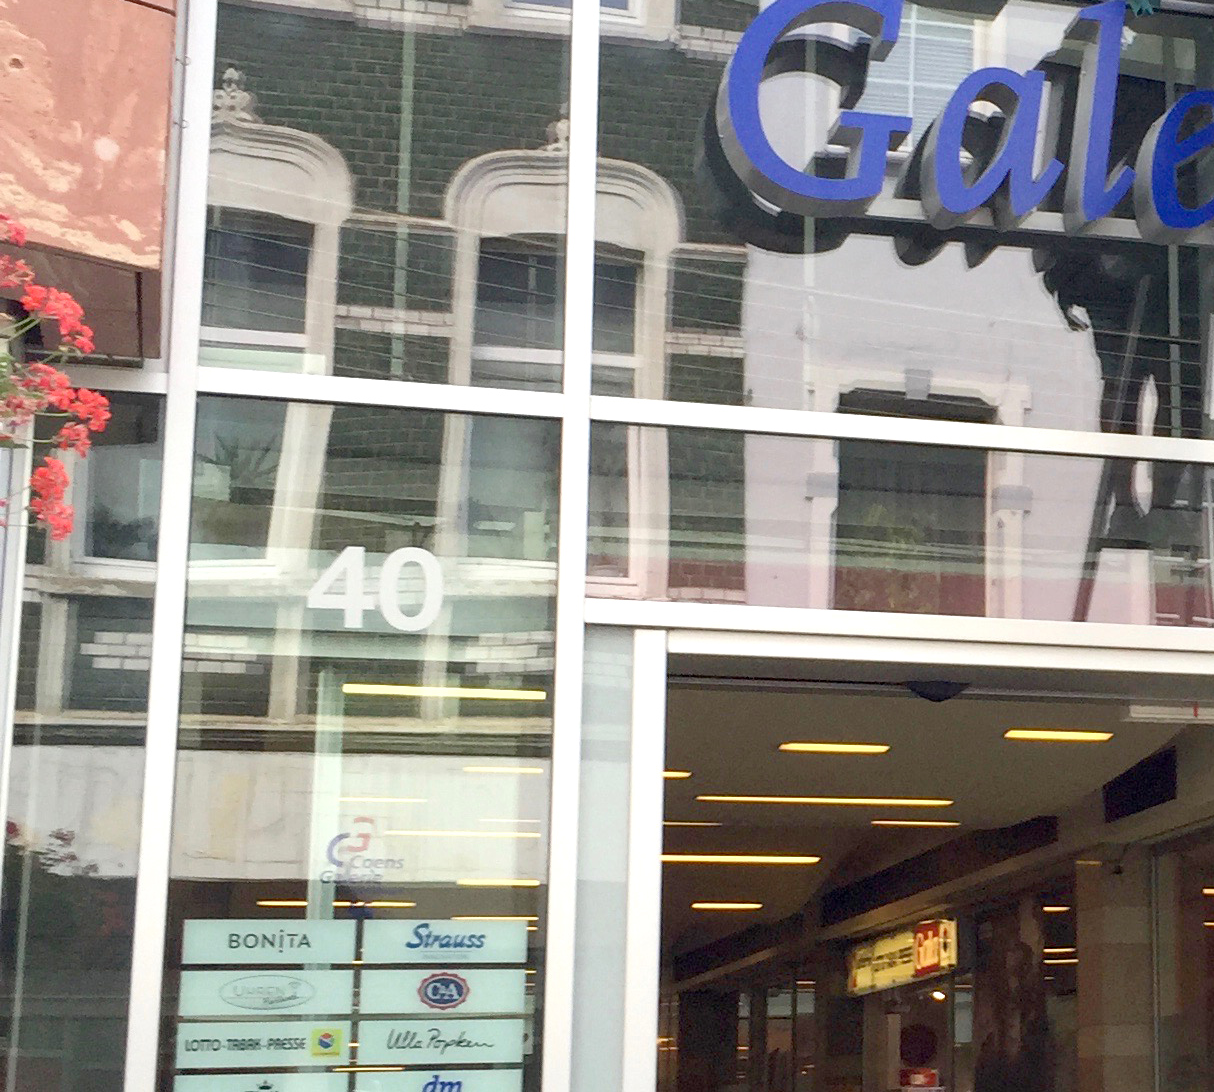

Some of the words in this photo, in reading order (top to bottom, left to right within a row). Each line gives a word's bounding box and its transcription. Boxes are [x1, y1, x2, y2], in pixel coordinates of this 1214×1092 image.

[307, 546, 444, 632] 40
[405, 922, 487, 949] Strauss
[422, 1074, 463, 1092] dm
